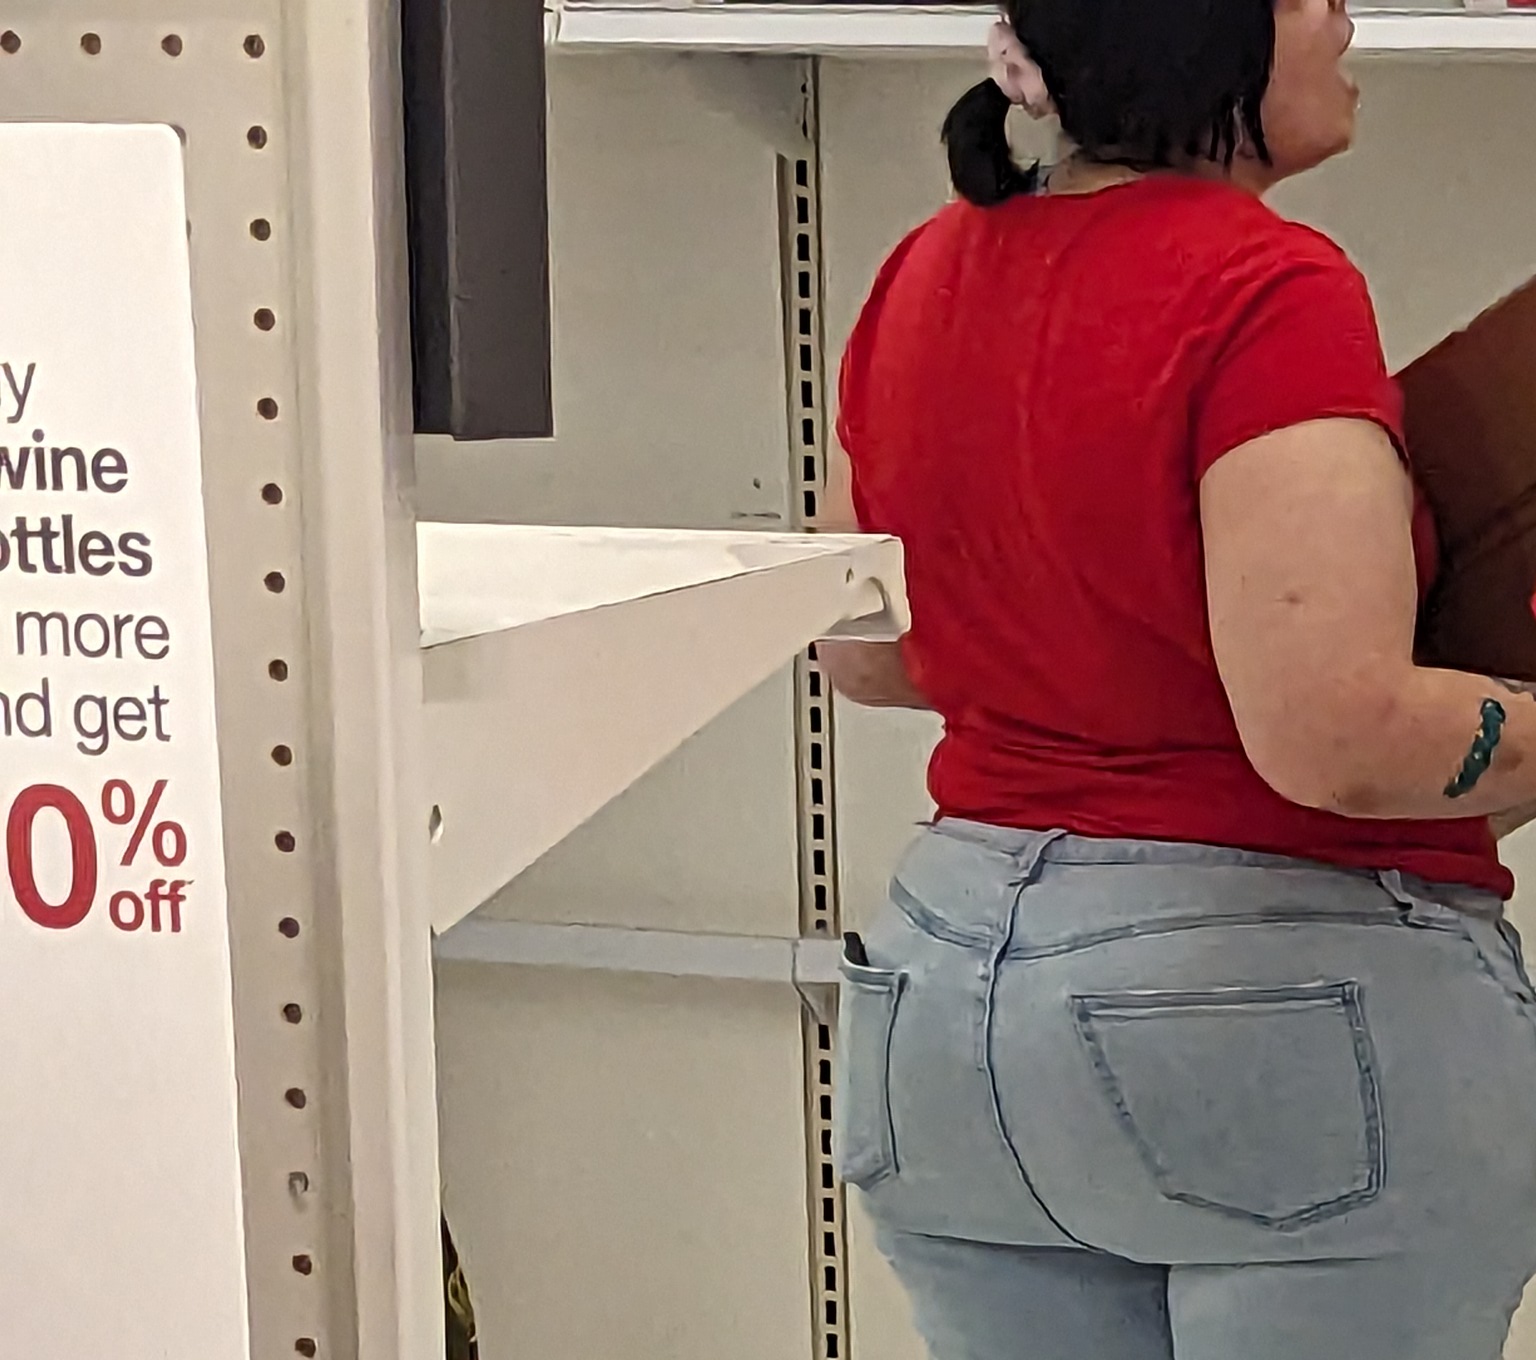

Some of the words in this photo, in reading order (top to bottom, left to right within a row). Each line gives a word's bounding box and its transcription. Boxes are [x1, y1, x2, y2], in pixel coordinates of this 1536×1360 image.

[16, 611, 170, 660] more
[73, 684, 172, 756] get
[109, 878, 188, 933] off
